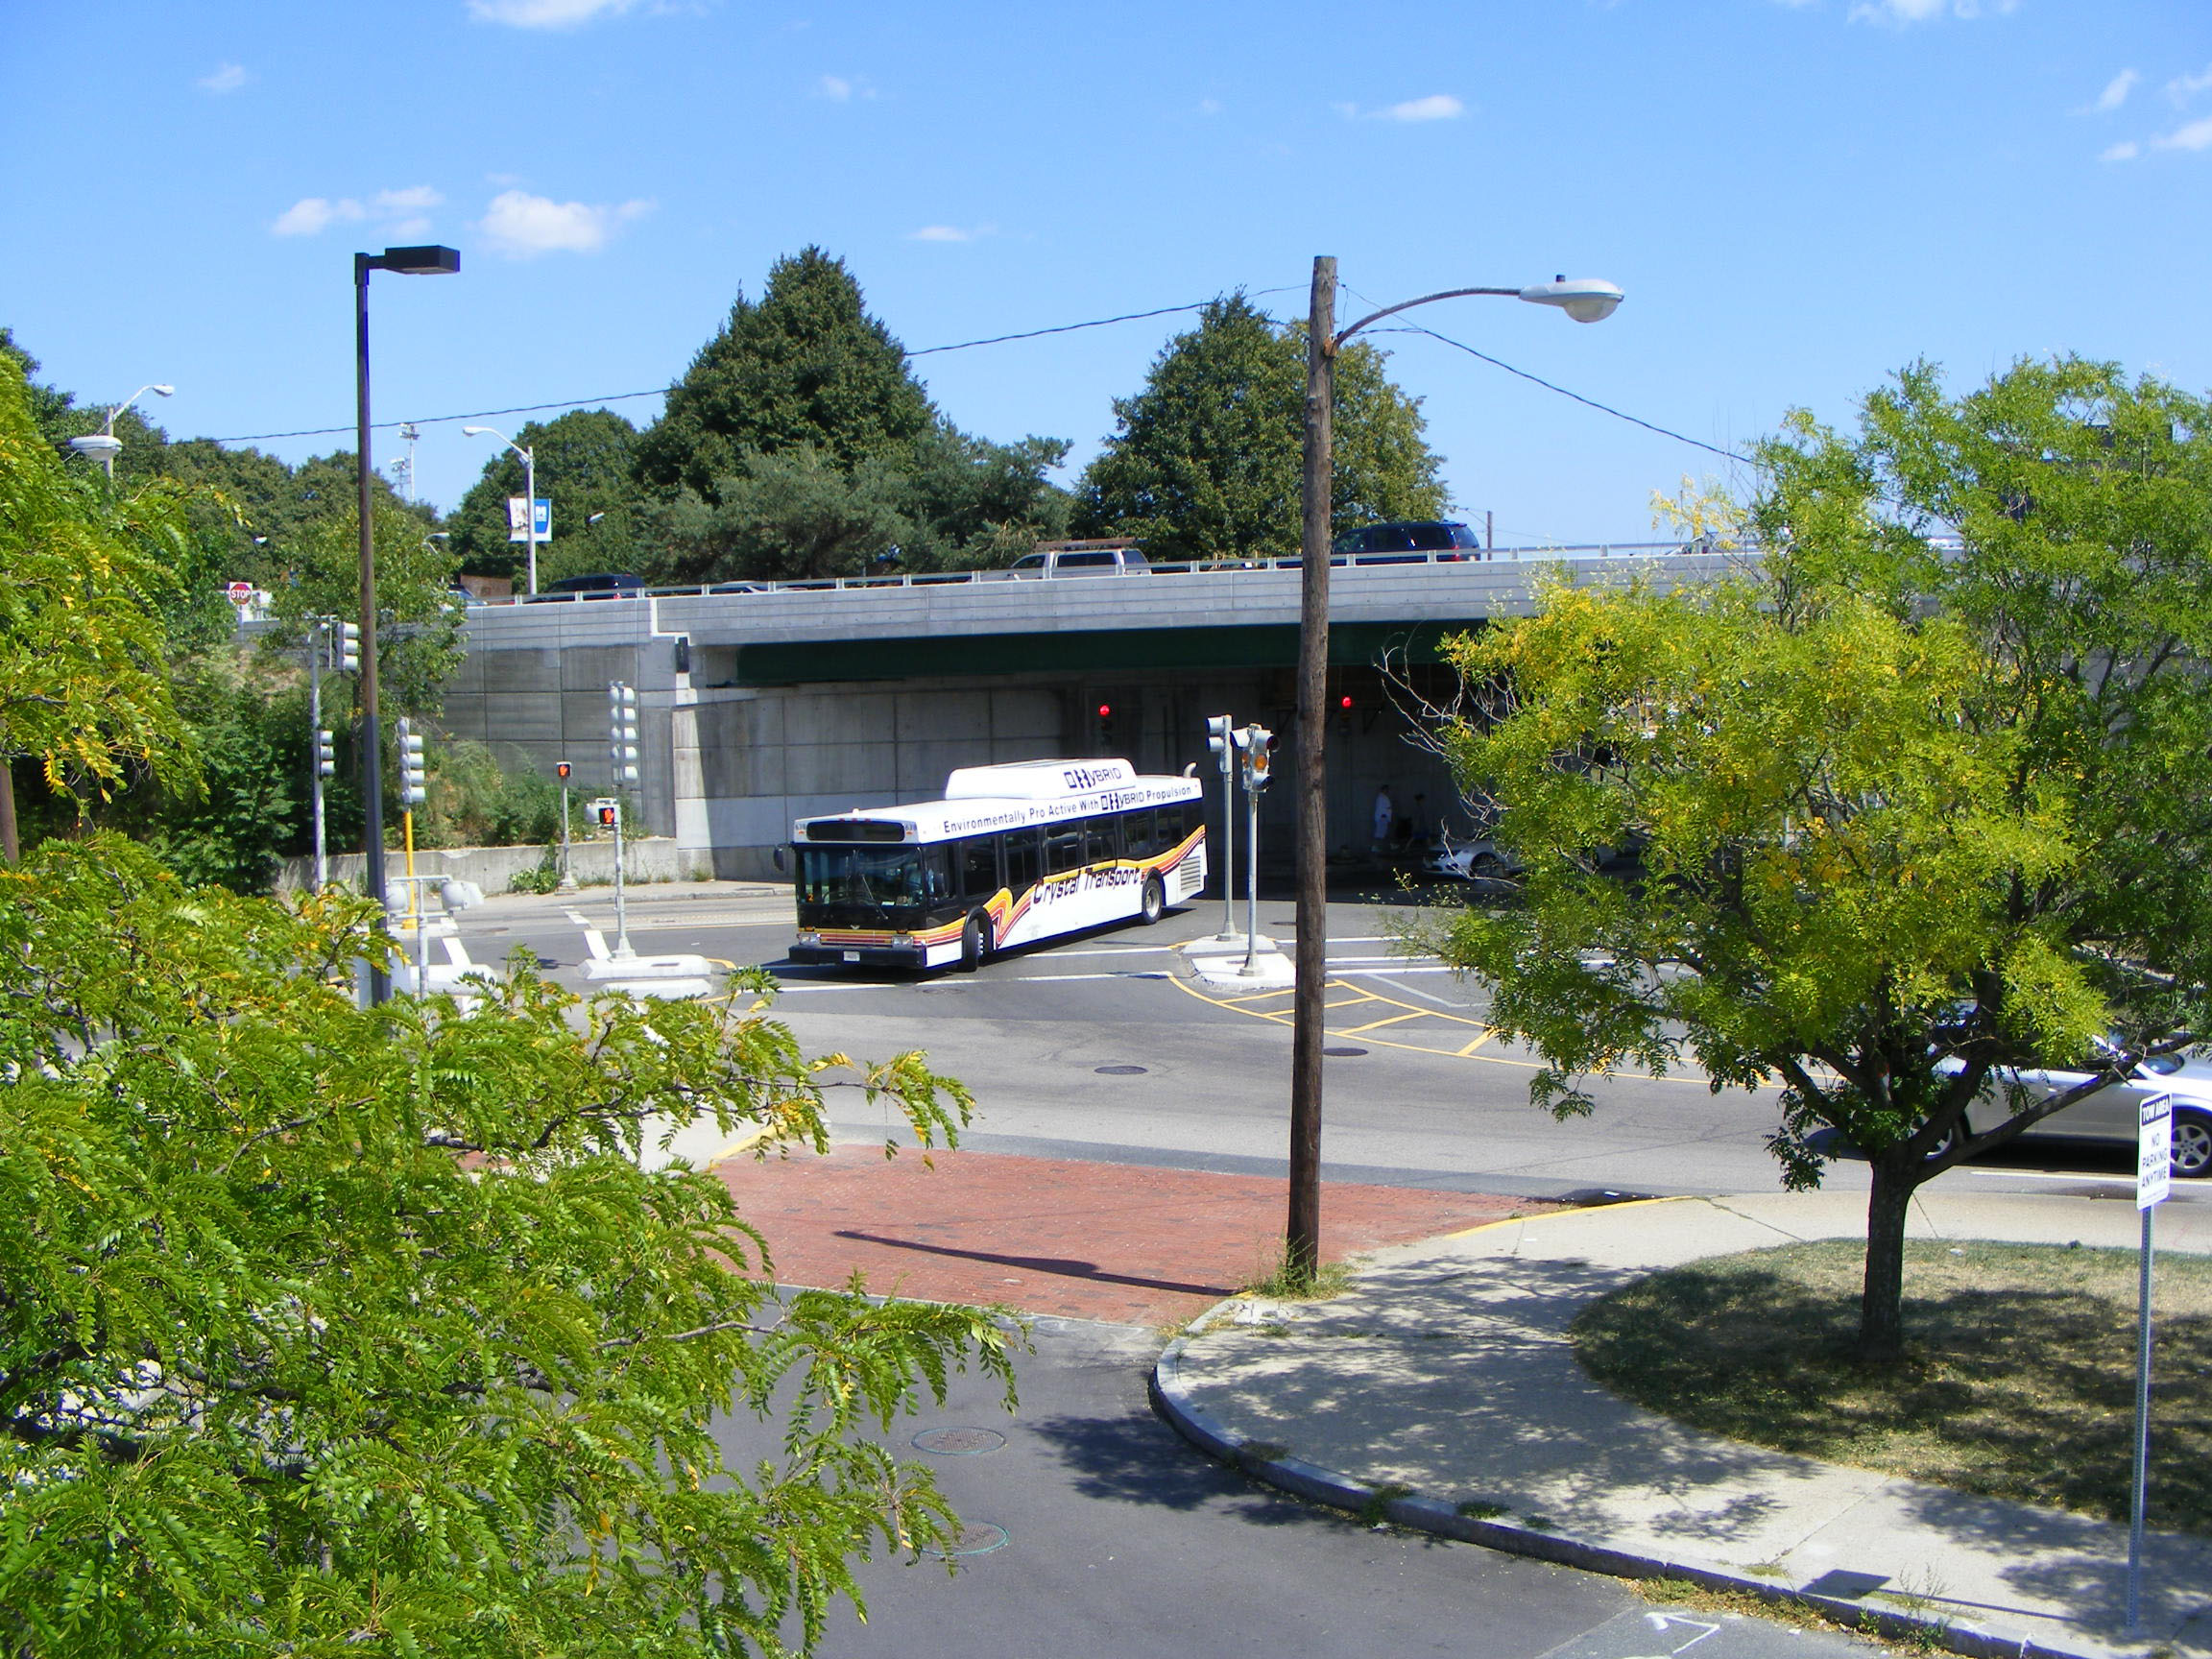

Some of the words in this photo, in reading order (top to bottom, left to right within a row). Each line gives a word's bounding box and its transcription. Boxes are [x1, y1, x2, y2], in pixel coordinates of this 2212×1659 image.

[231, 589, 251, 599] STOP
[944, 810, 1025, 833] Environmentally
[1029, 807, 1046, 820] Pro
[1048, 802, 1077, 816] Active
[1079, 798, 1099, 813] With
[1146, 786, 1191, 802] Propulsion
[1033, 868, 1081, 904] Crystal
[1084, 866, 1140, 891] Transport
[2142, 1103, 2155, 1122] TOW
[2155, 1097, 2169, 1118] AREA
[2152, 1133, 2160, 1148] NO
[2142, 1147, 2167, 1168] PARKING
[2142, 1166, 2167, 1188] ANYTIME
